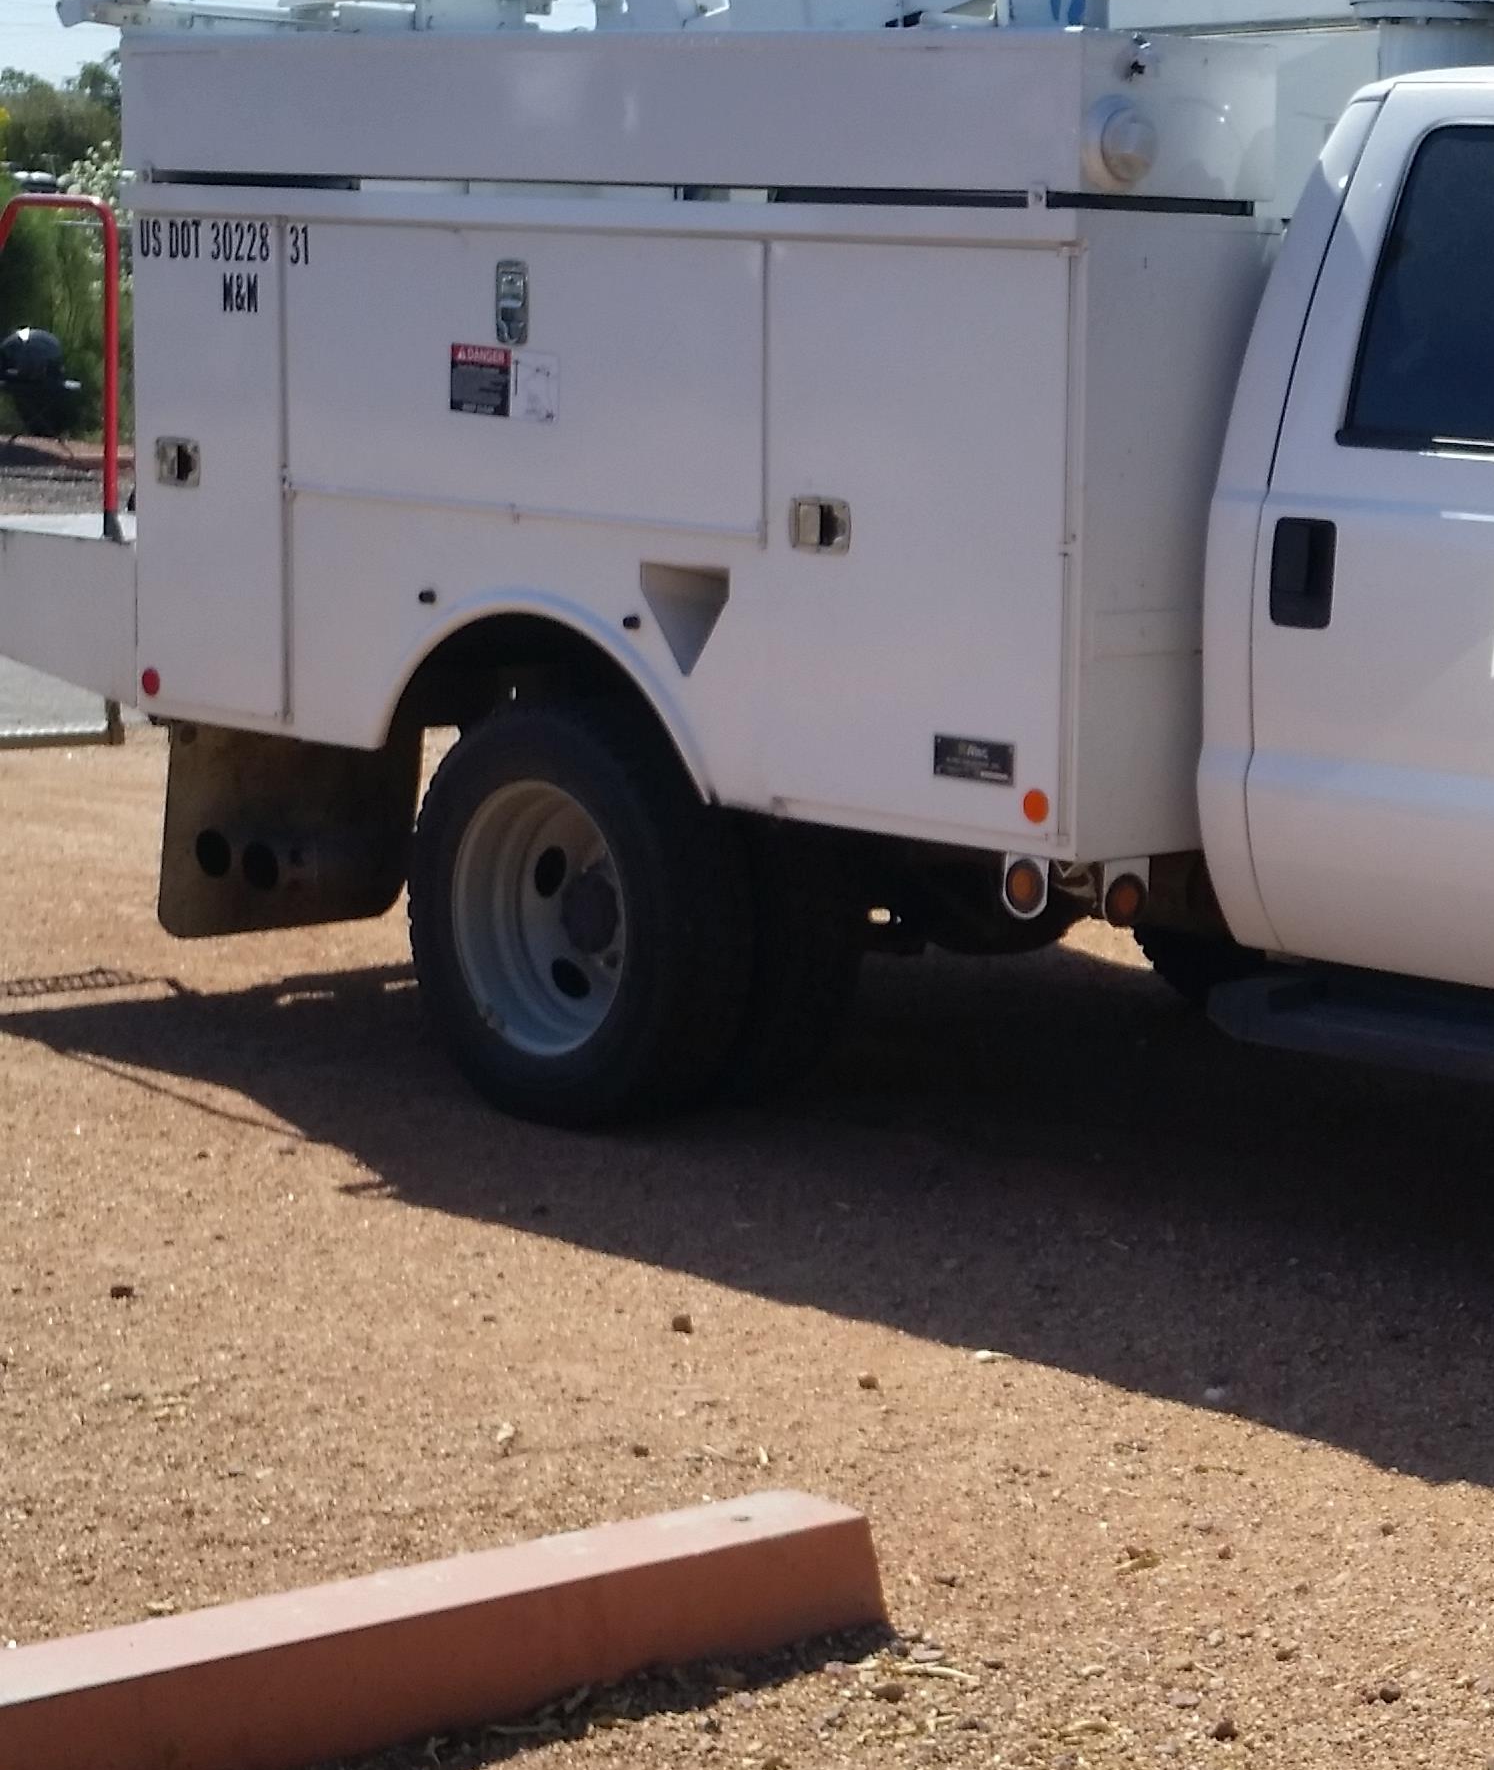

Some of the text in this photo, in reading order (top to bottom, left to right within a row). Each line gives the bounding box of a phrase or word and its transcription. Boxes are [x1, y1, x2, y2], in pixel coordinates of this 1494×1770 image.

[140, 219, 309, 265] US DOT 30228 31
[467, 348, 505, 366] DANGER
